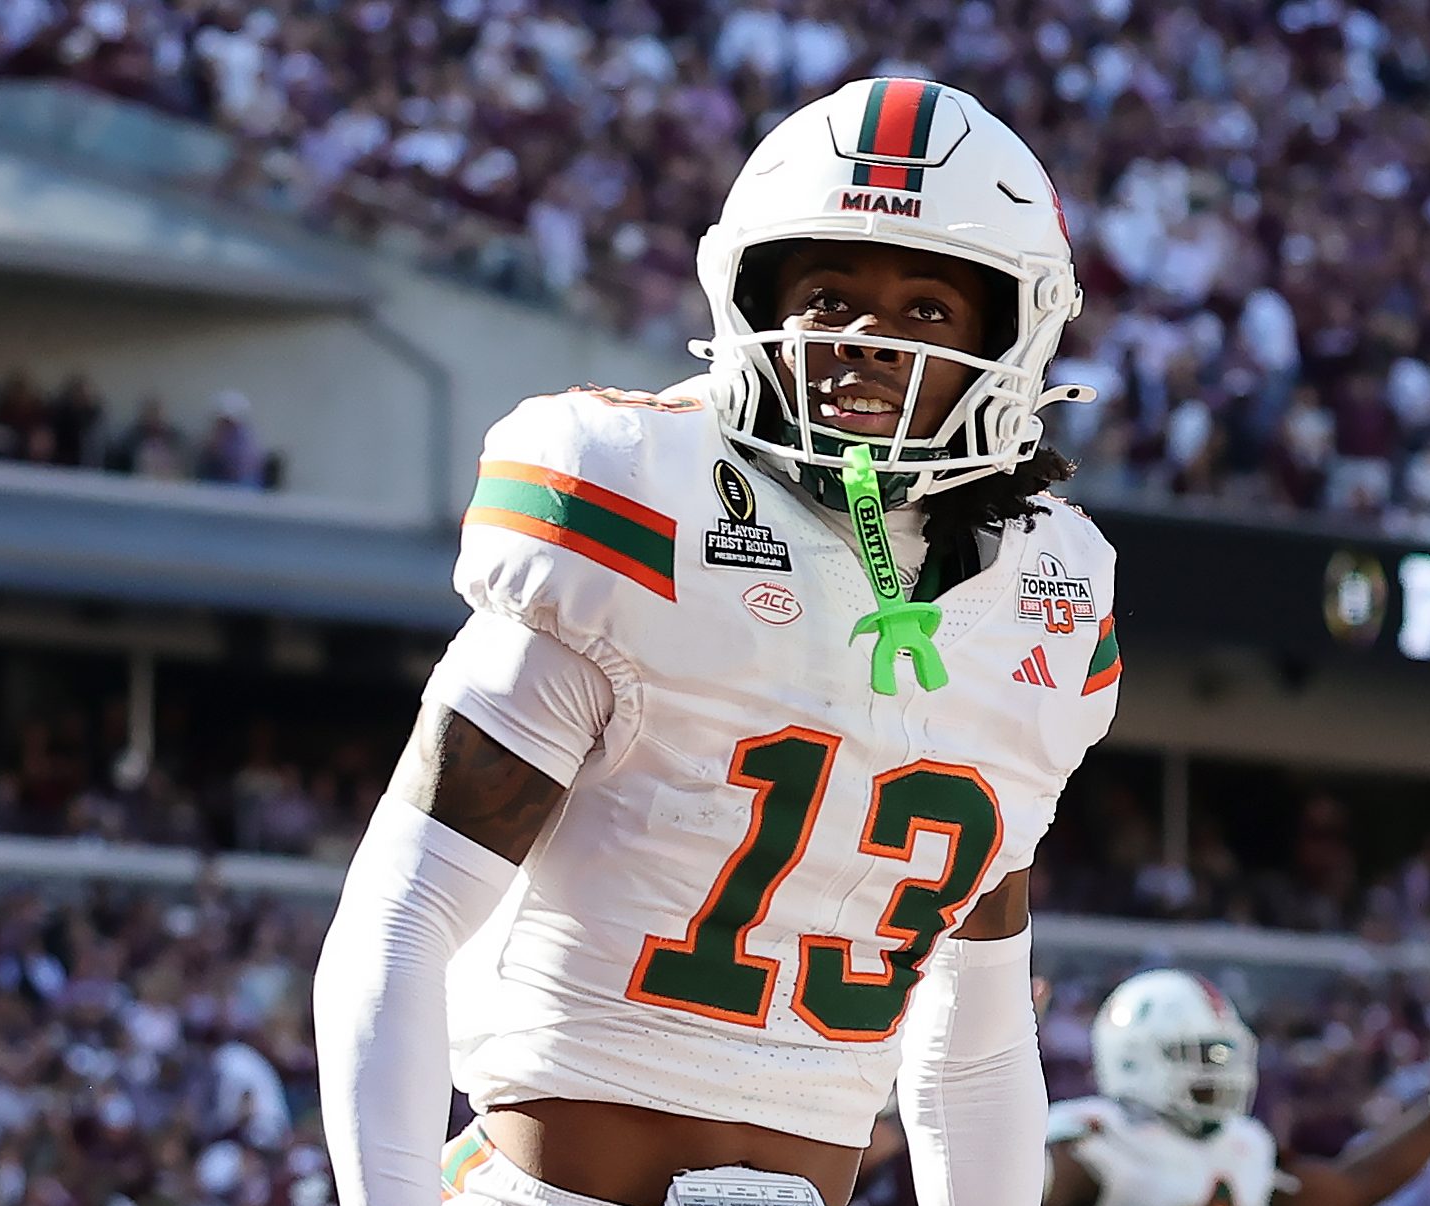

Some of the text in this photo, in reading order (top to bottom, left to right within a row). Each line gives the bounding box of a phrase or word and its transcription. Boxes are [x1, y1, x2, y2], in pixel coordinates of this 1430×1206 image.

[840, 191, 921, 218] MIAMI
[720, 521, 769, 541] PLAYOFF
[708, 535, 786, 556] FIRST ROUND
[860, 505, 895, 590] BATTLE
[1041, 560, 1058, 577] U
[1022, 578, 1089, 598] TORRETTA
[752, 592, 795, 612] ACC
[1042, 598, 1075, 634] 13
[625, 725, 1004, 1042] 13
